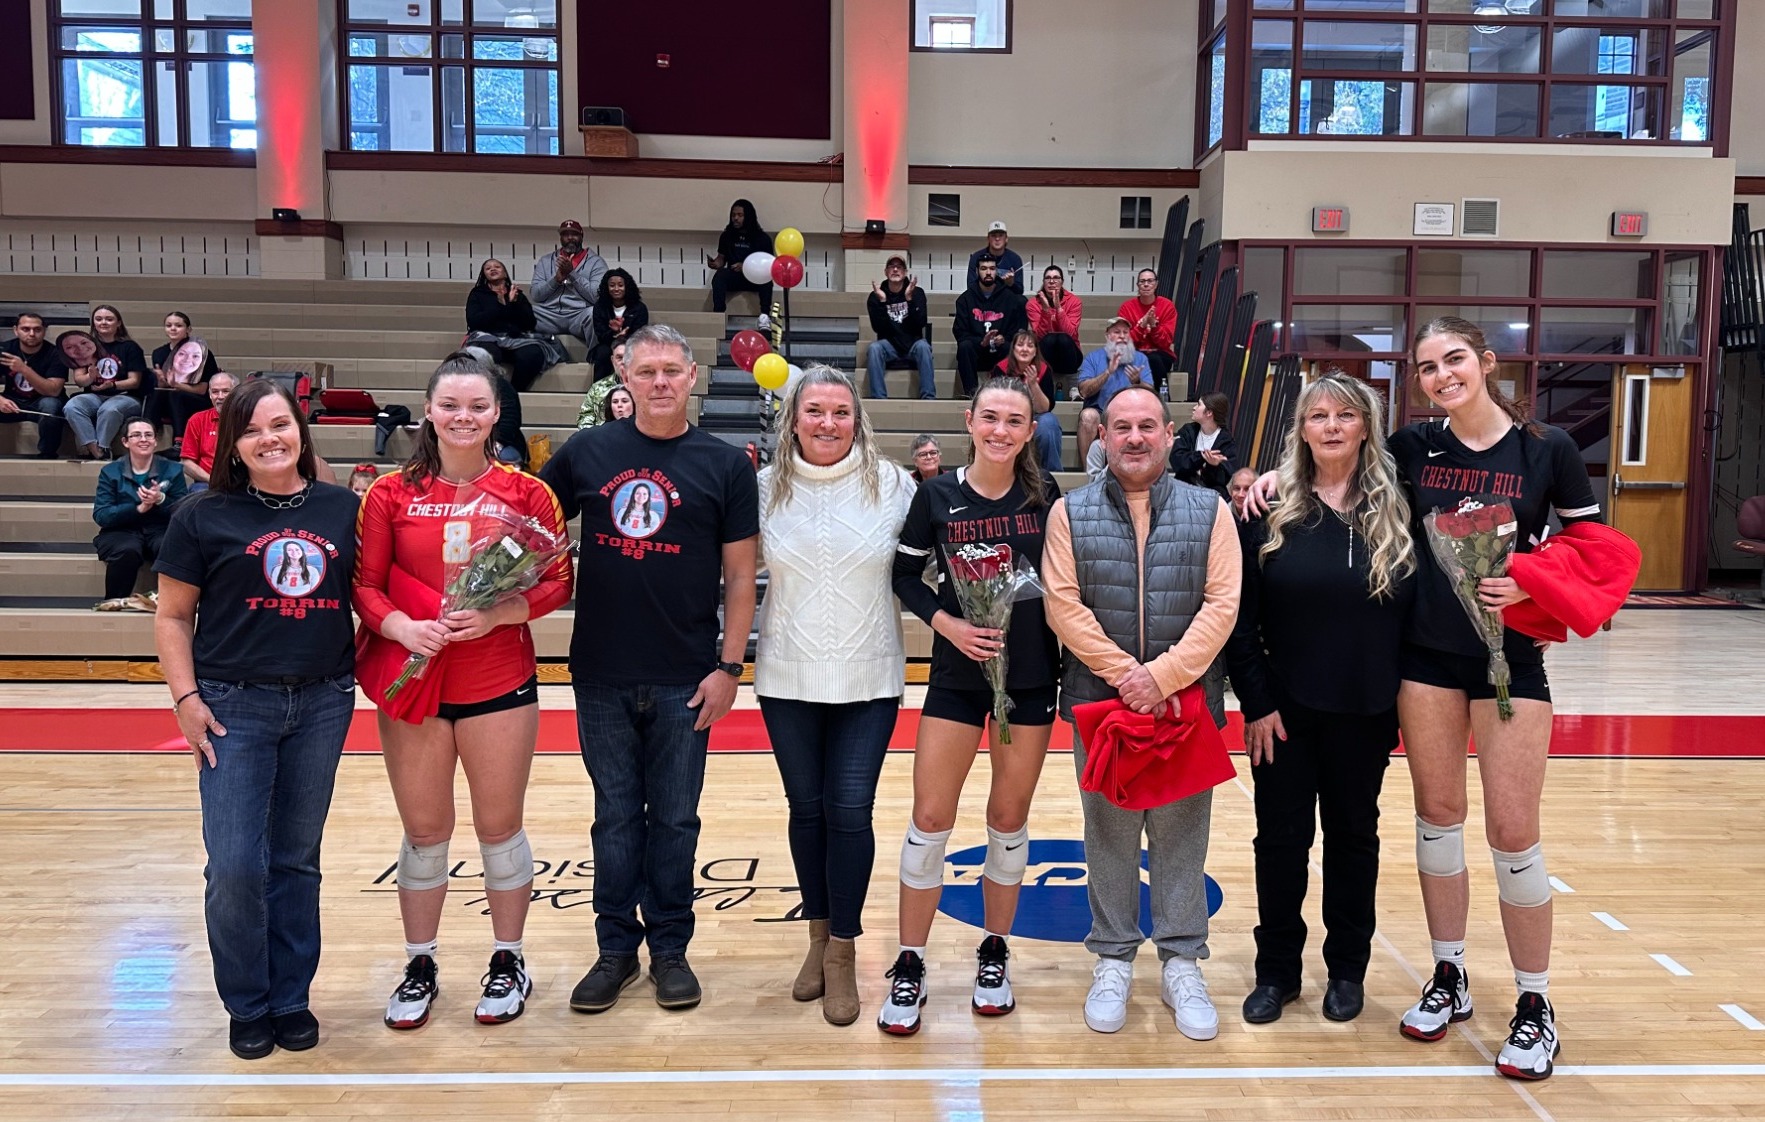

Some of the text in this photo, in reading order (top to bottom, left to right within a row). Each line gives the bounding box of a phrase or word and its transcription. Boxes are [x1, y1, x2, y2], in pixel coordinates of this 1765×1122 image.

[1319, 209, 1343, 229] EXIT
[1620, 214, 1643, 233] EXIT
[599, 469, 636, 497] PROUD
[1421, 465, 1523, 499] CHESTNUT HILL
[947, 513, 1040, 543] CHESTNUT HILL
[245, 531, 280, 556] PROUD
[442, 521, 471, 564] 8
[595, 533, 681, 554] TORRIN
[621, 547, 645, 560] #8
[245, 597, 340, 610] TORRIN
[279, 607, 306, 619] #8
[448, 858, 760, 884] Dsin
